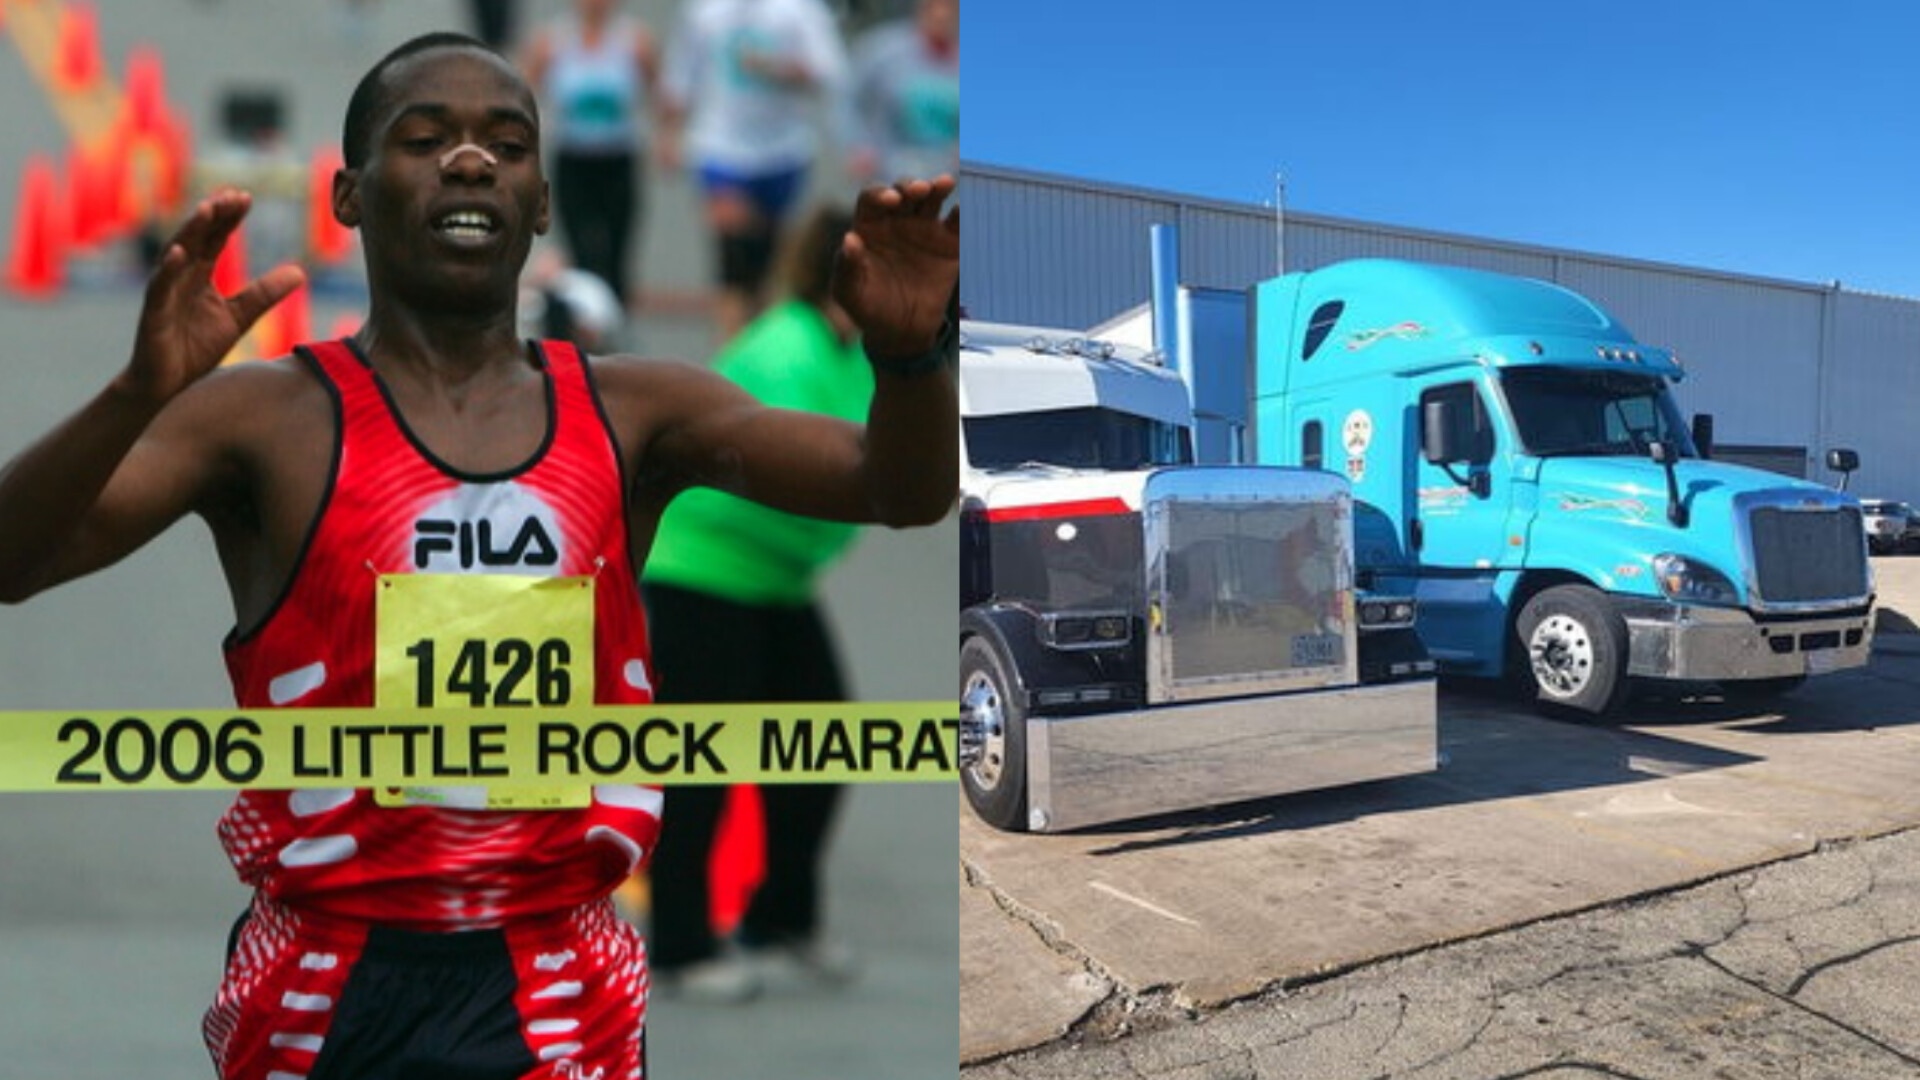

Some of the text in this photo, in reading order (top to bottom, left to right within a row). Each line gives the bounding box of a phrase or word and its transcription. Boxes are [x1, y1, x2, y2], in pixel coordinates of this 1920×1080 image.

[413, 515, 558, 569] FILA
[405, 637, 571, 708] 1426
[56, 717, 264, 784] 2006
[292, 725, 508, 777] LITTLE
[537, 719, 728, 776] ROCK
